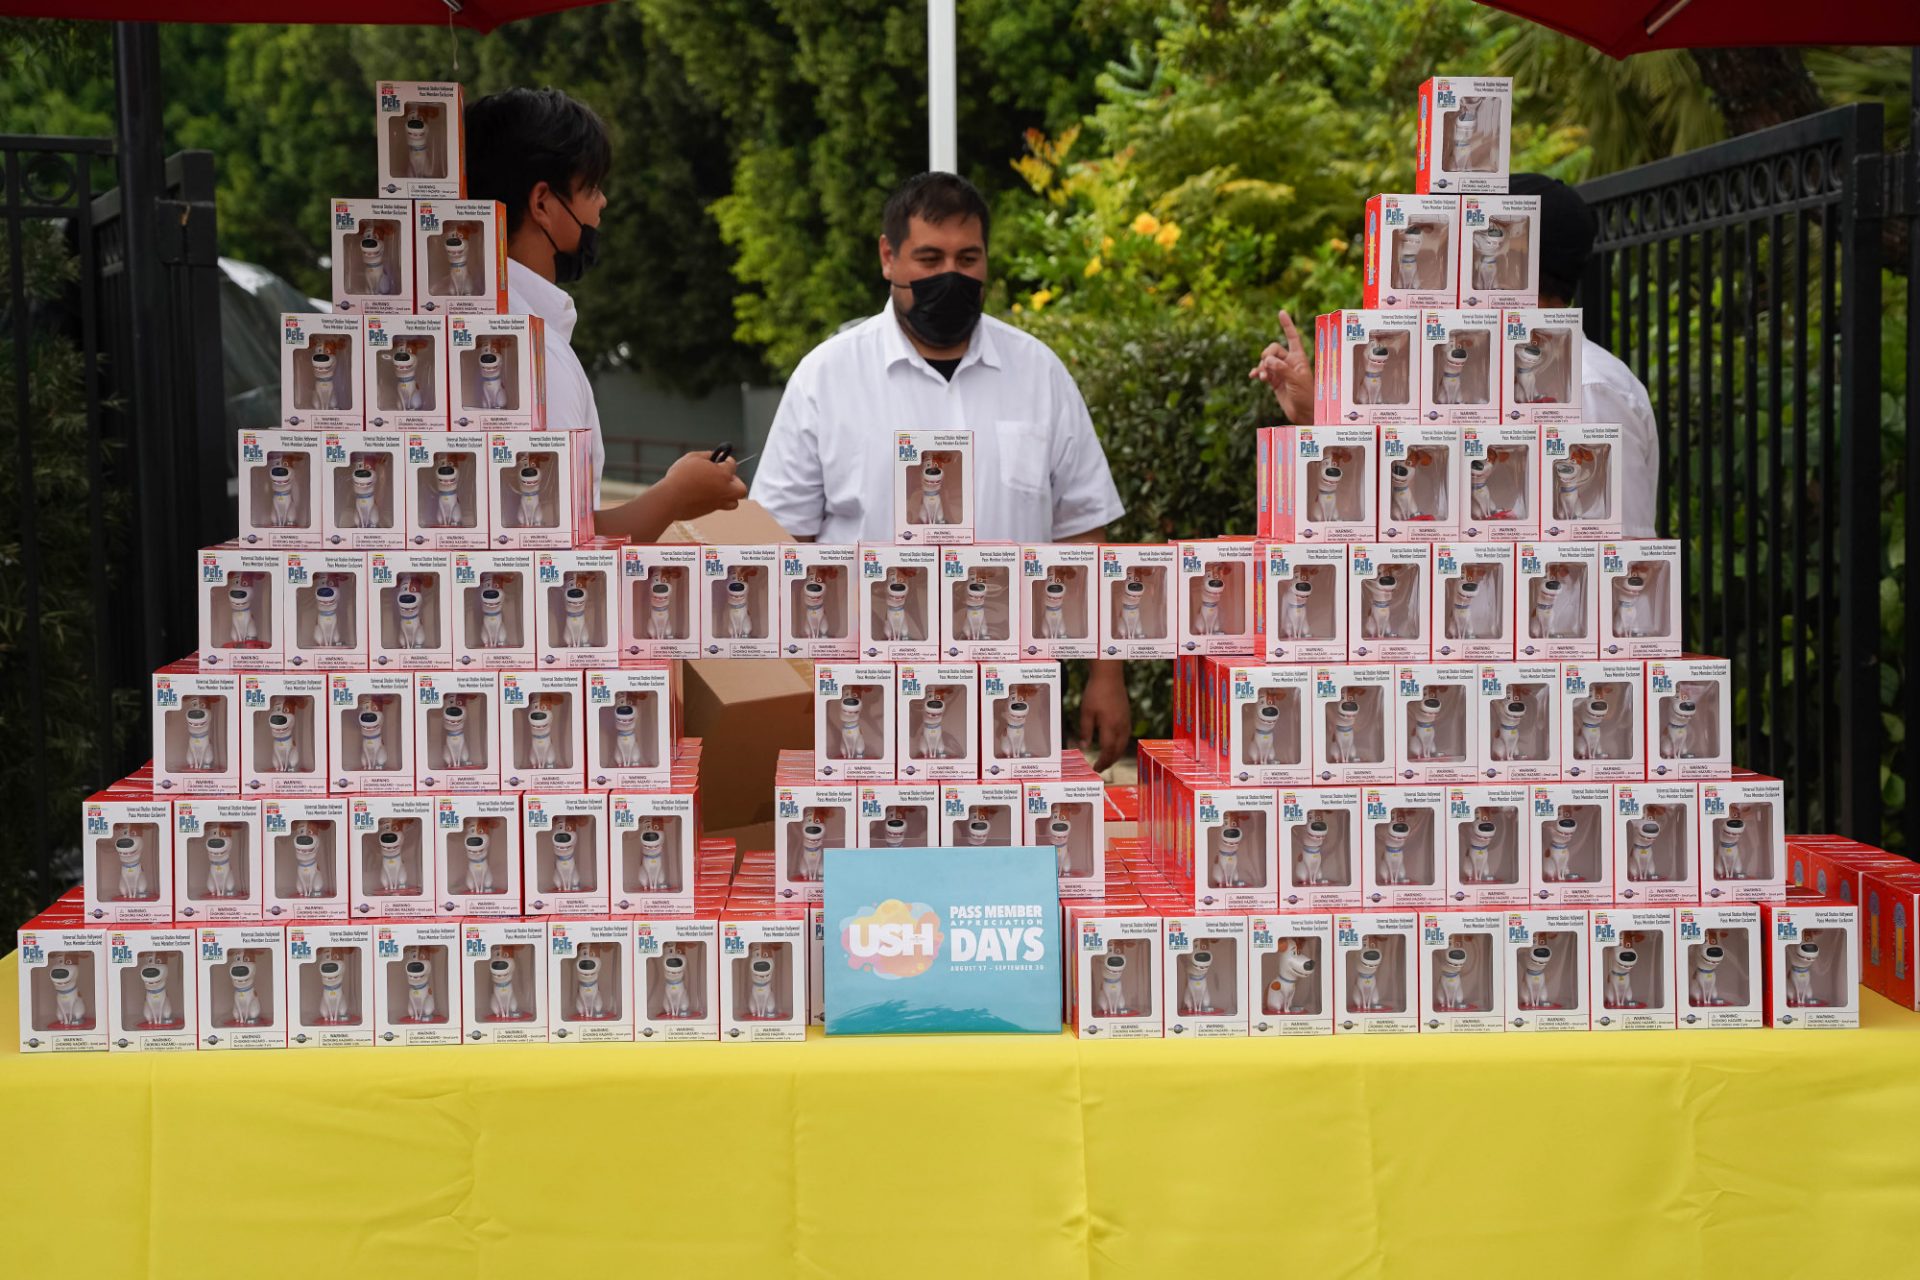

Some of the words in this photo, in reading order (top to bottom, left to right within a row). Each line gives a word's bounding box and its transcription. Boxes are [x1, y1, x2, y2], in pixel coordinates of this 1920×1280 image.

[950, 906, 982, 918] PASS
[985, 905, 1042, 918] MEMBER
[849, 923, 933, 957] USH
[951, 927, 1044, 962] DAYS
